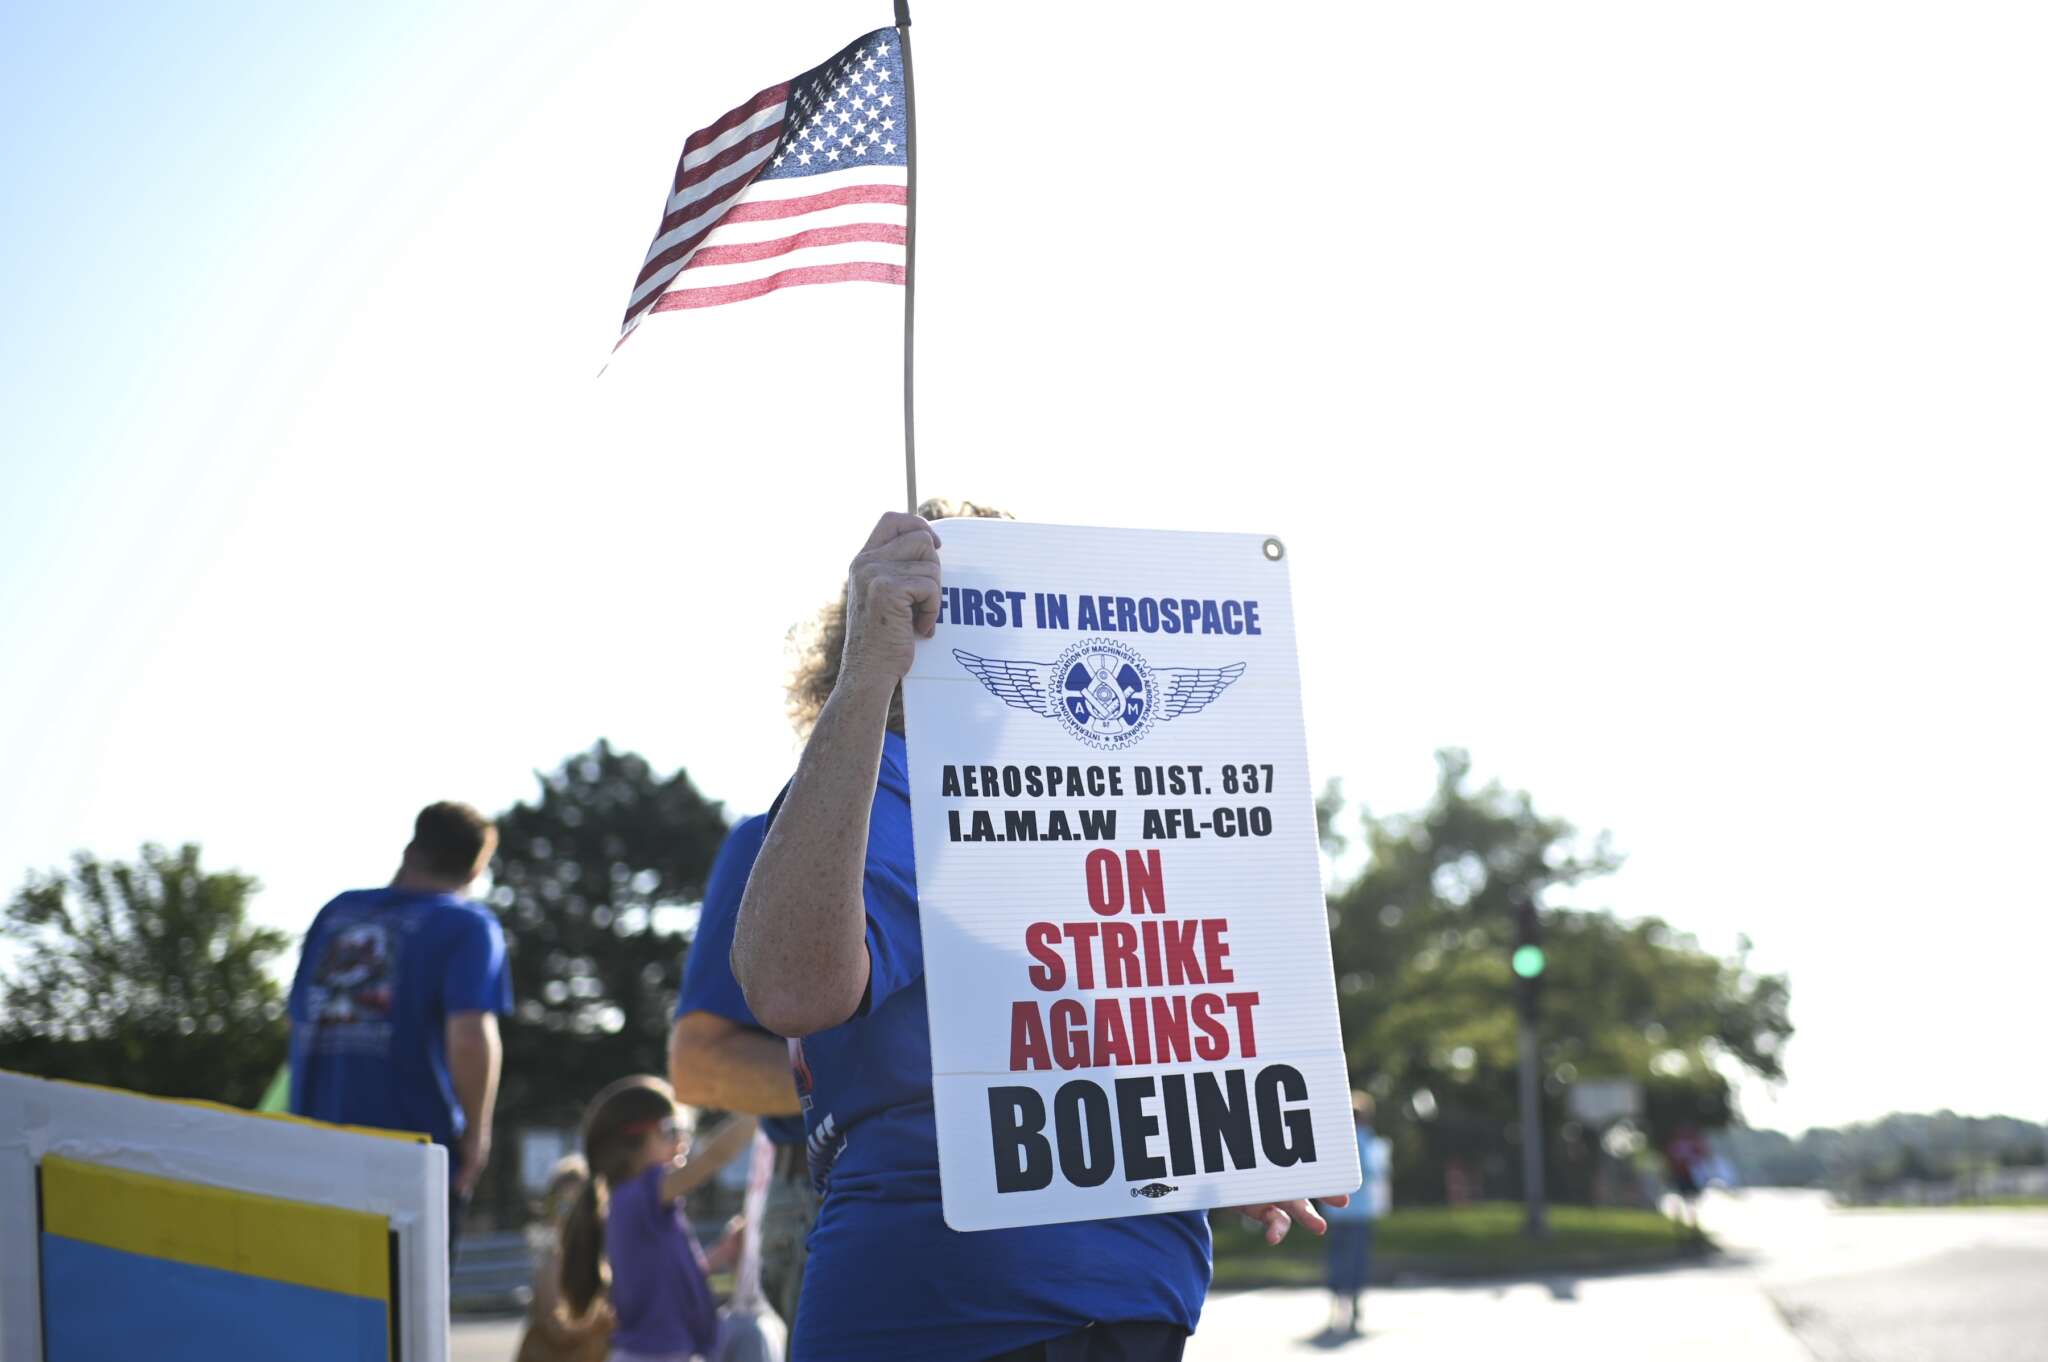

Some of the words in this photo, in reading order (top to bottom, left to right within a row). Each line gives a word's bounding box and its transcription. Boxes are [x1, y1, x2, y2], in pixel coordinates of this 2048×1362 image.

[1035, 593, 1069, 629] IN
[1078, 596, 1261, 635] AEROSPACE
[1081, 647, 1090, 656] OF
[1091, 645, 1134, 664] MACHINISTS
[1134, 662, 1147, 679] AND
[1056, 652, 1081, 695] ASSOCIATION
[1057, 697, 1101, 741] INTERNATIONAL
[1075, 702, 1085, 714] A
[1127, 703, 1139, 715] M
[1113, 720, 1145, 742] WORKERS
[942, 765, 1123, 797] AEROSPACE
[1135, 765, 1212, 796] DIST.
[1223, 764, 1274, 794] 837
[948, 810, 1117, 842] I.A.M.A.W
[1142, 807, 1273, 840] AFL-CIO
[1085, 848, 1166, 917] ON
[1025, 918, 1234, 992] STRIKE
[1009, 991, 1260, 1072] AGAINST
[987, 1063, 1317, 1194] BOEING
